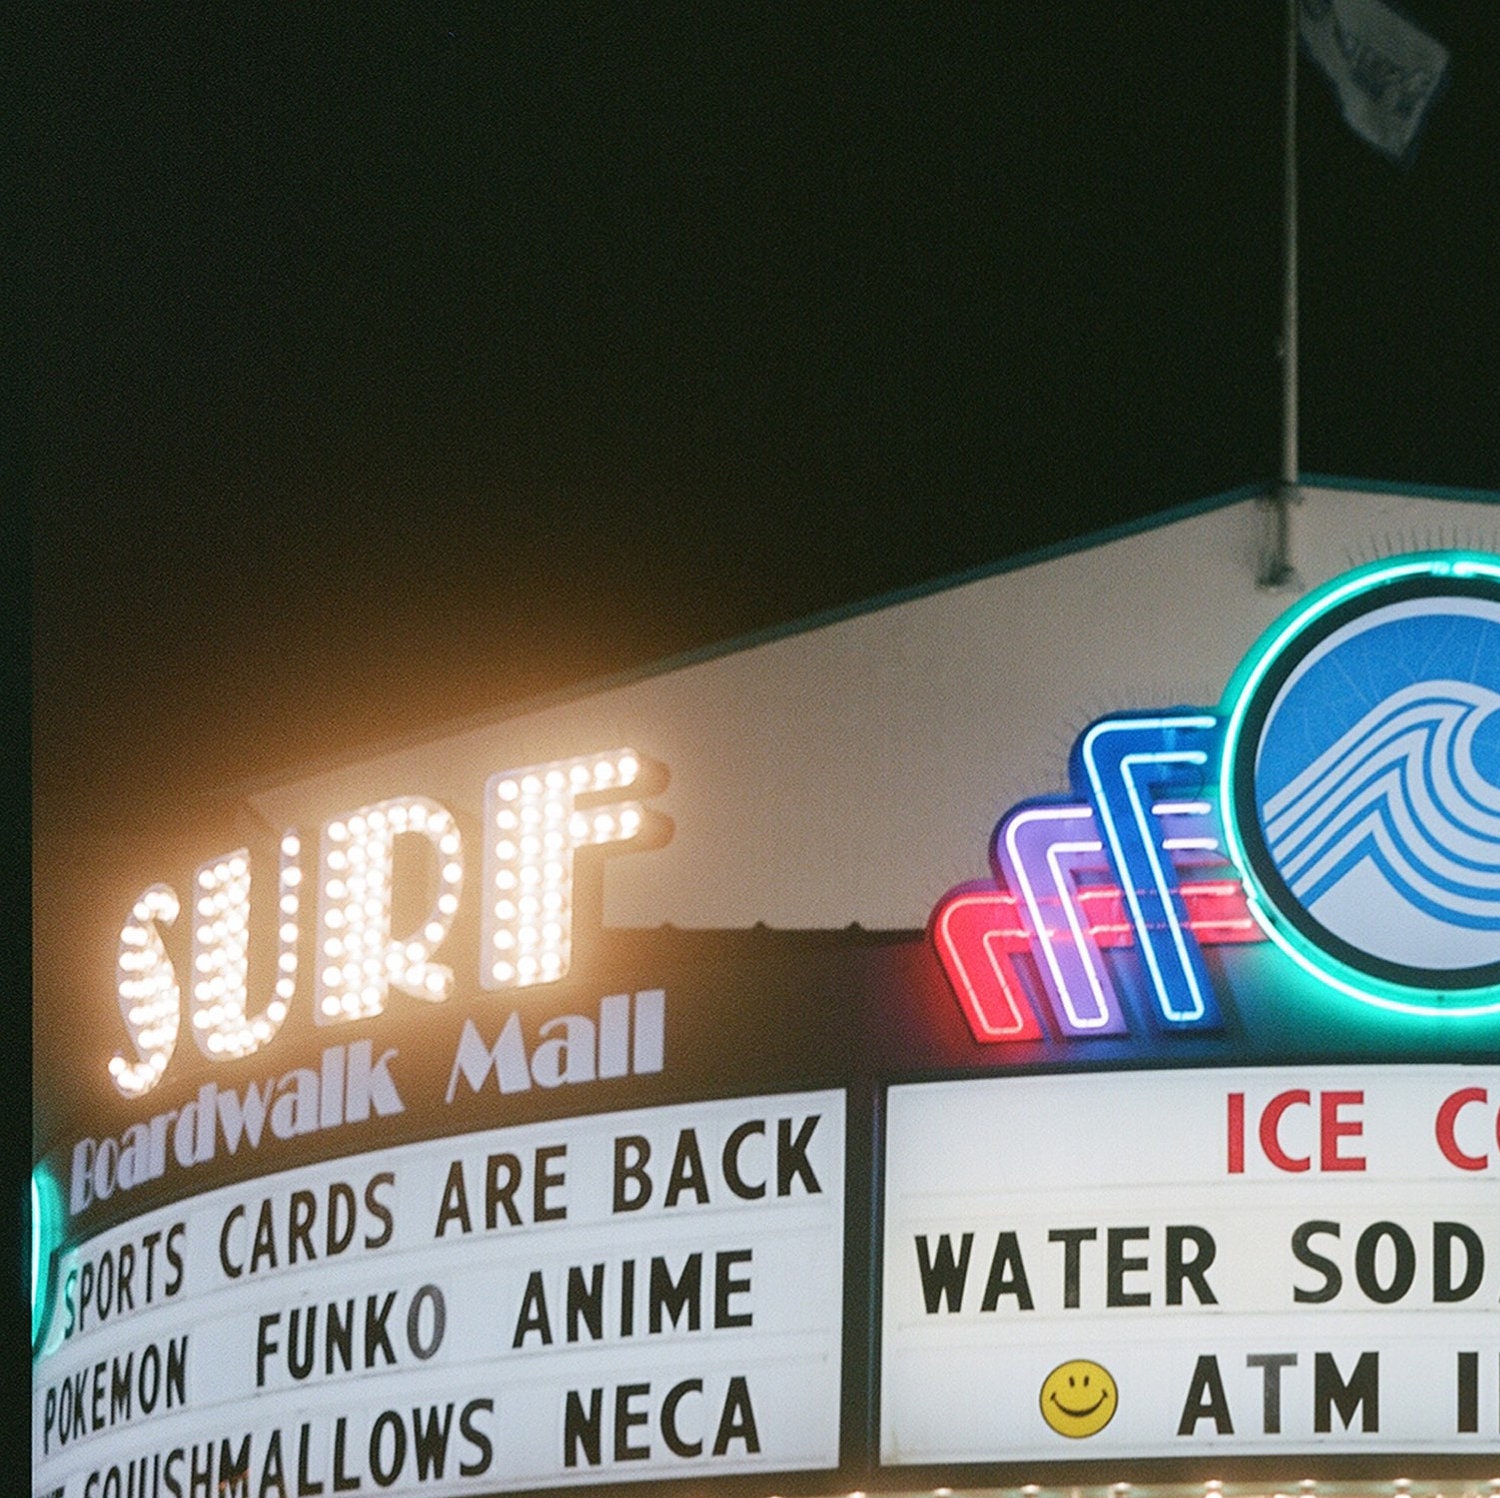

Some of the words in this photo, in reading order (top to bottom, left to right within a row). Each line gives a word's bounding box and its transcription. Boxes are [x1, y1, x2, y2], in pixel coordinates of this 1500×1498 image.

[109, 747, 641, 1098] SURF
[70, 1038, 405, 1215] Boardwalk
[445, 989, 667, 1105] Mall
[1227, 1089, 1365, 1174] ICE
[63, 1222, 186, 1340] SPORTS
[219, 1171, 394, 1279] CARDS
[434, 1144, 569, 1239] ARE
[612, 1113, 825, 1214] BACK
[914, 1223, 1218, 1314] WATER
[44, 1335, 188, 1456] POKEMON
[256, 1284, 446, 1387] FUNKO
[512, 1249, 754, 1350] ANIME
[564, 1375, 761, 1469] NECA
[1176, 1351, 1380, 1436] ATM
